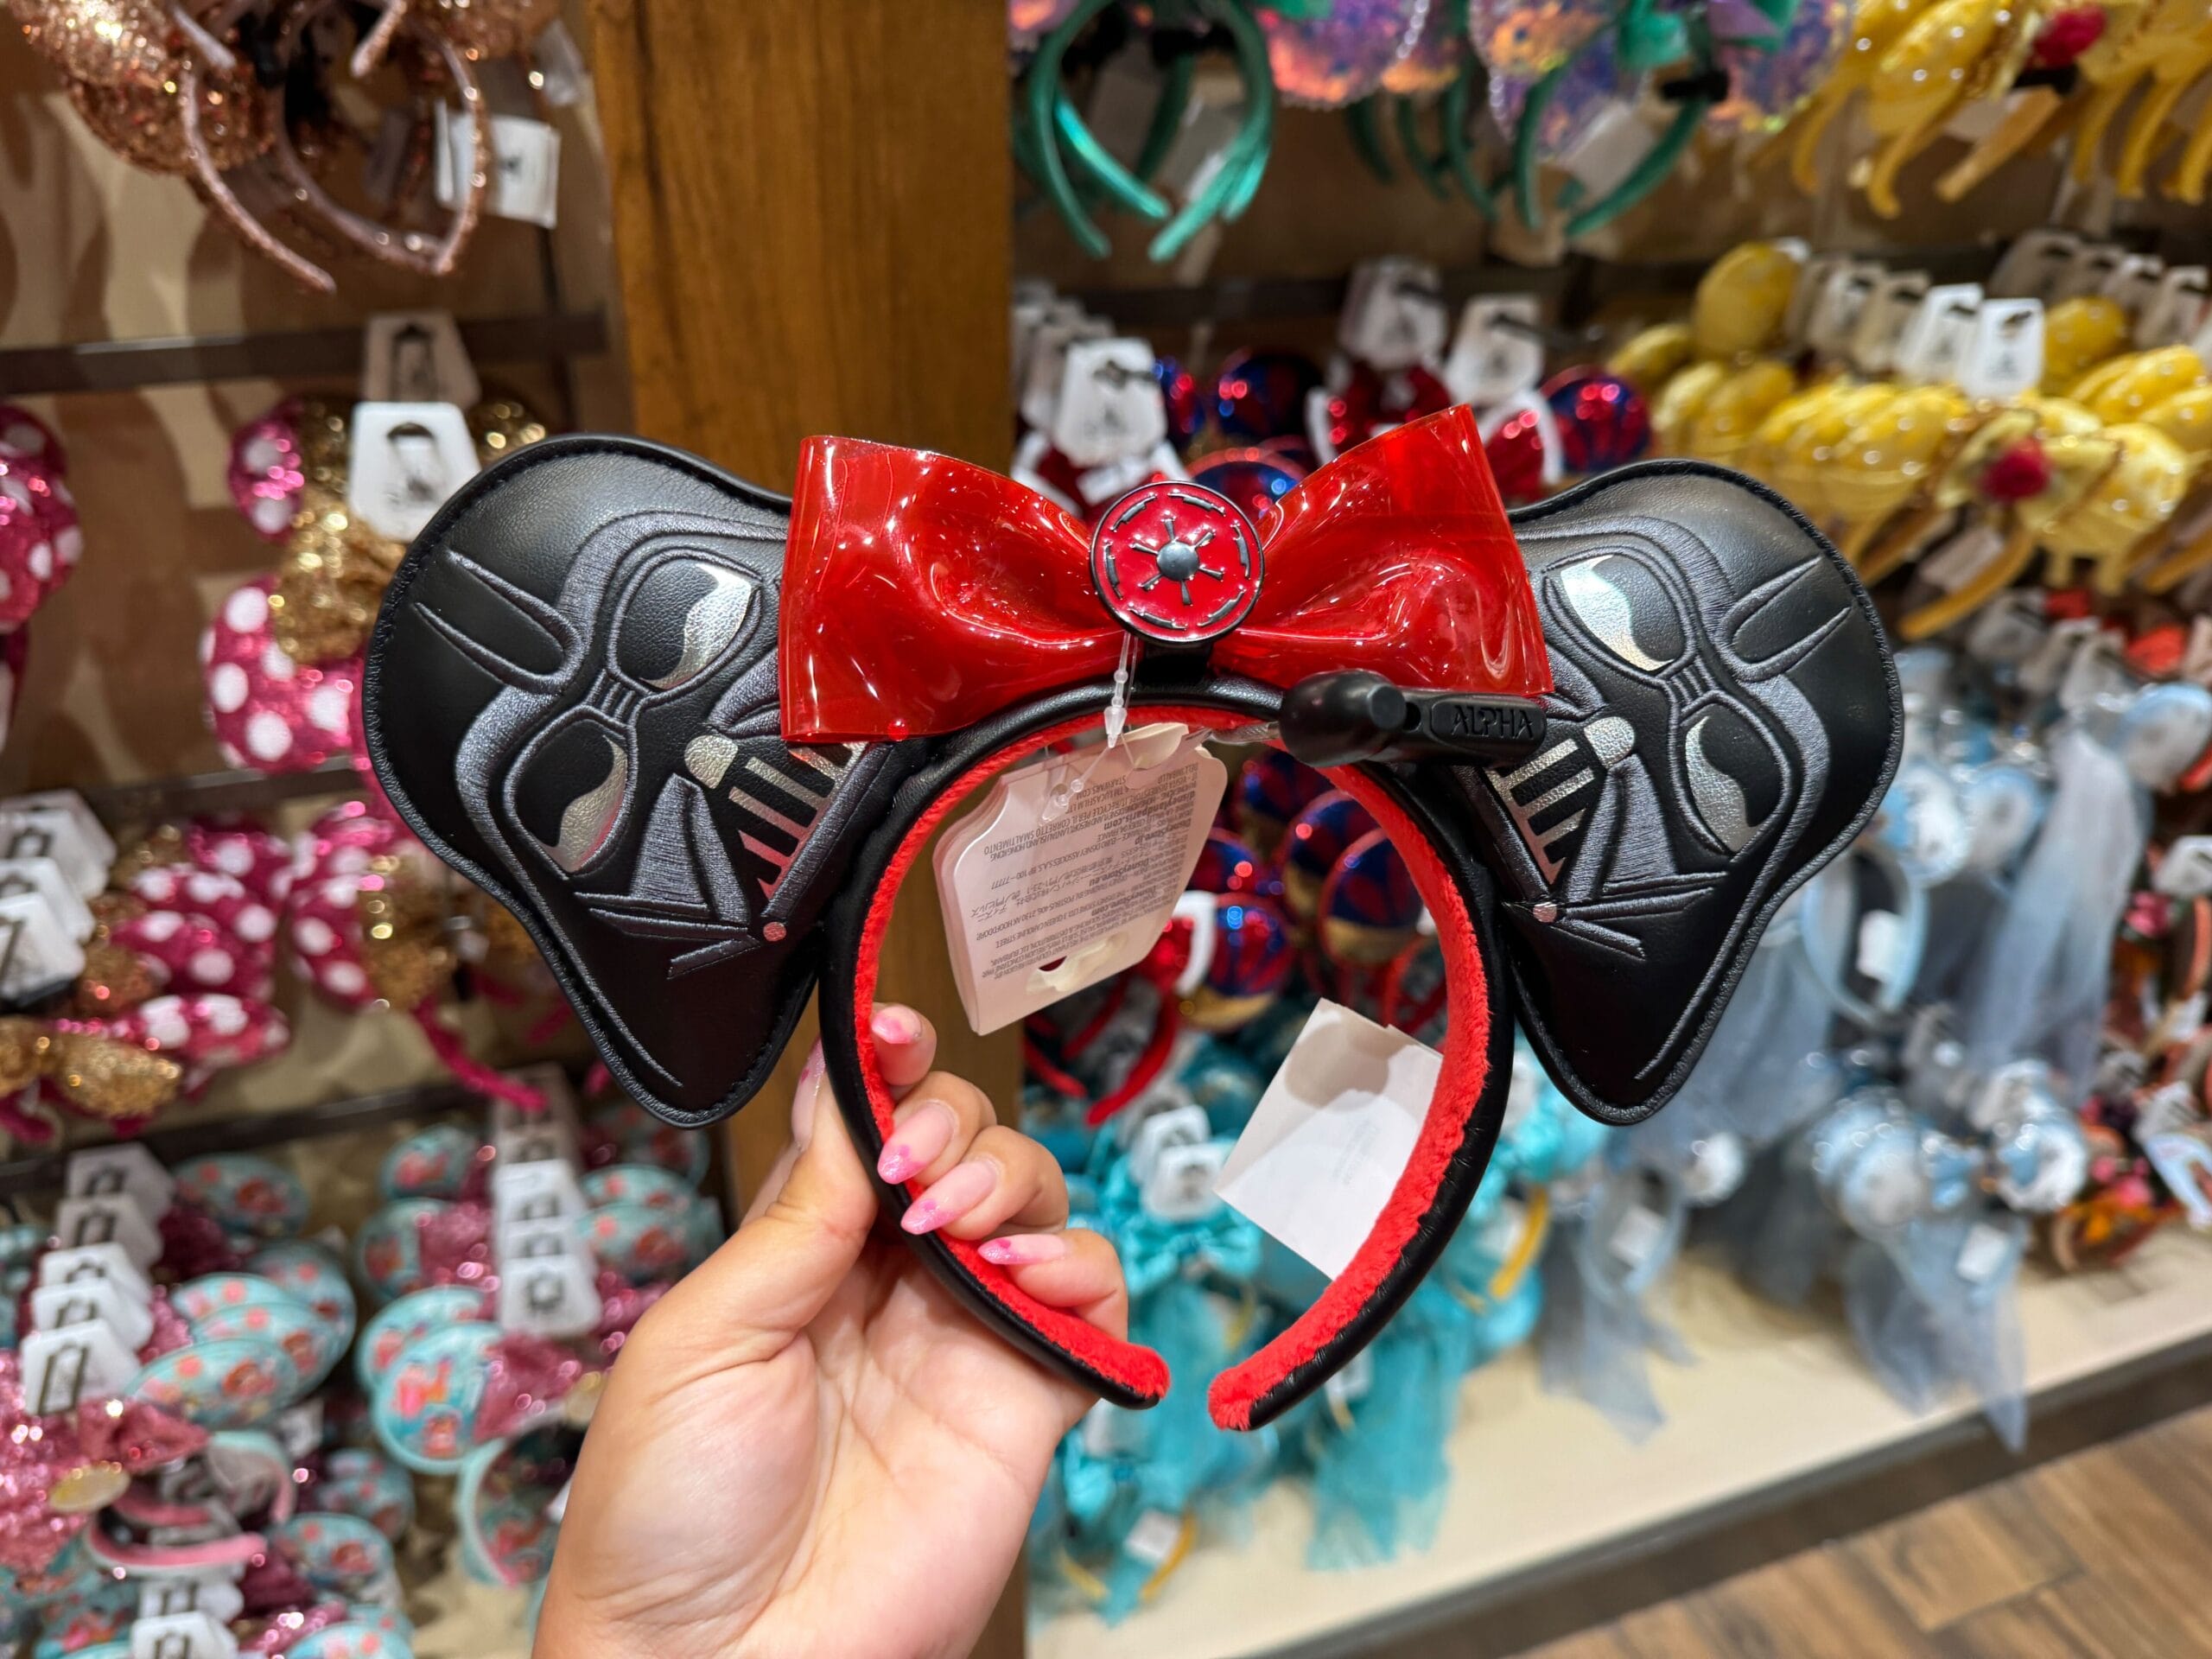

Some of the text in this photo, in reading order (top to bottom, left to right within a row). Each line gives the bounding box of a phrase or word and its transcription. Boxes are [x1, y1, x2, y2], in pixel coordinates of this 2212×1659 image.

[1451, 704, 1535, 740] ALPHA
[1077, 789, 1113, 810] LUCASFILM
[1103, 787, 1196, 831] disneylandparis.com
[1035, 817, 1071, 837] CORRETTO
[983, 830, 1033, 856] SMALTIMENTO
